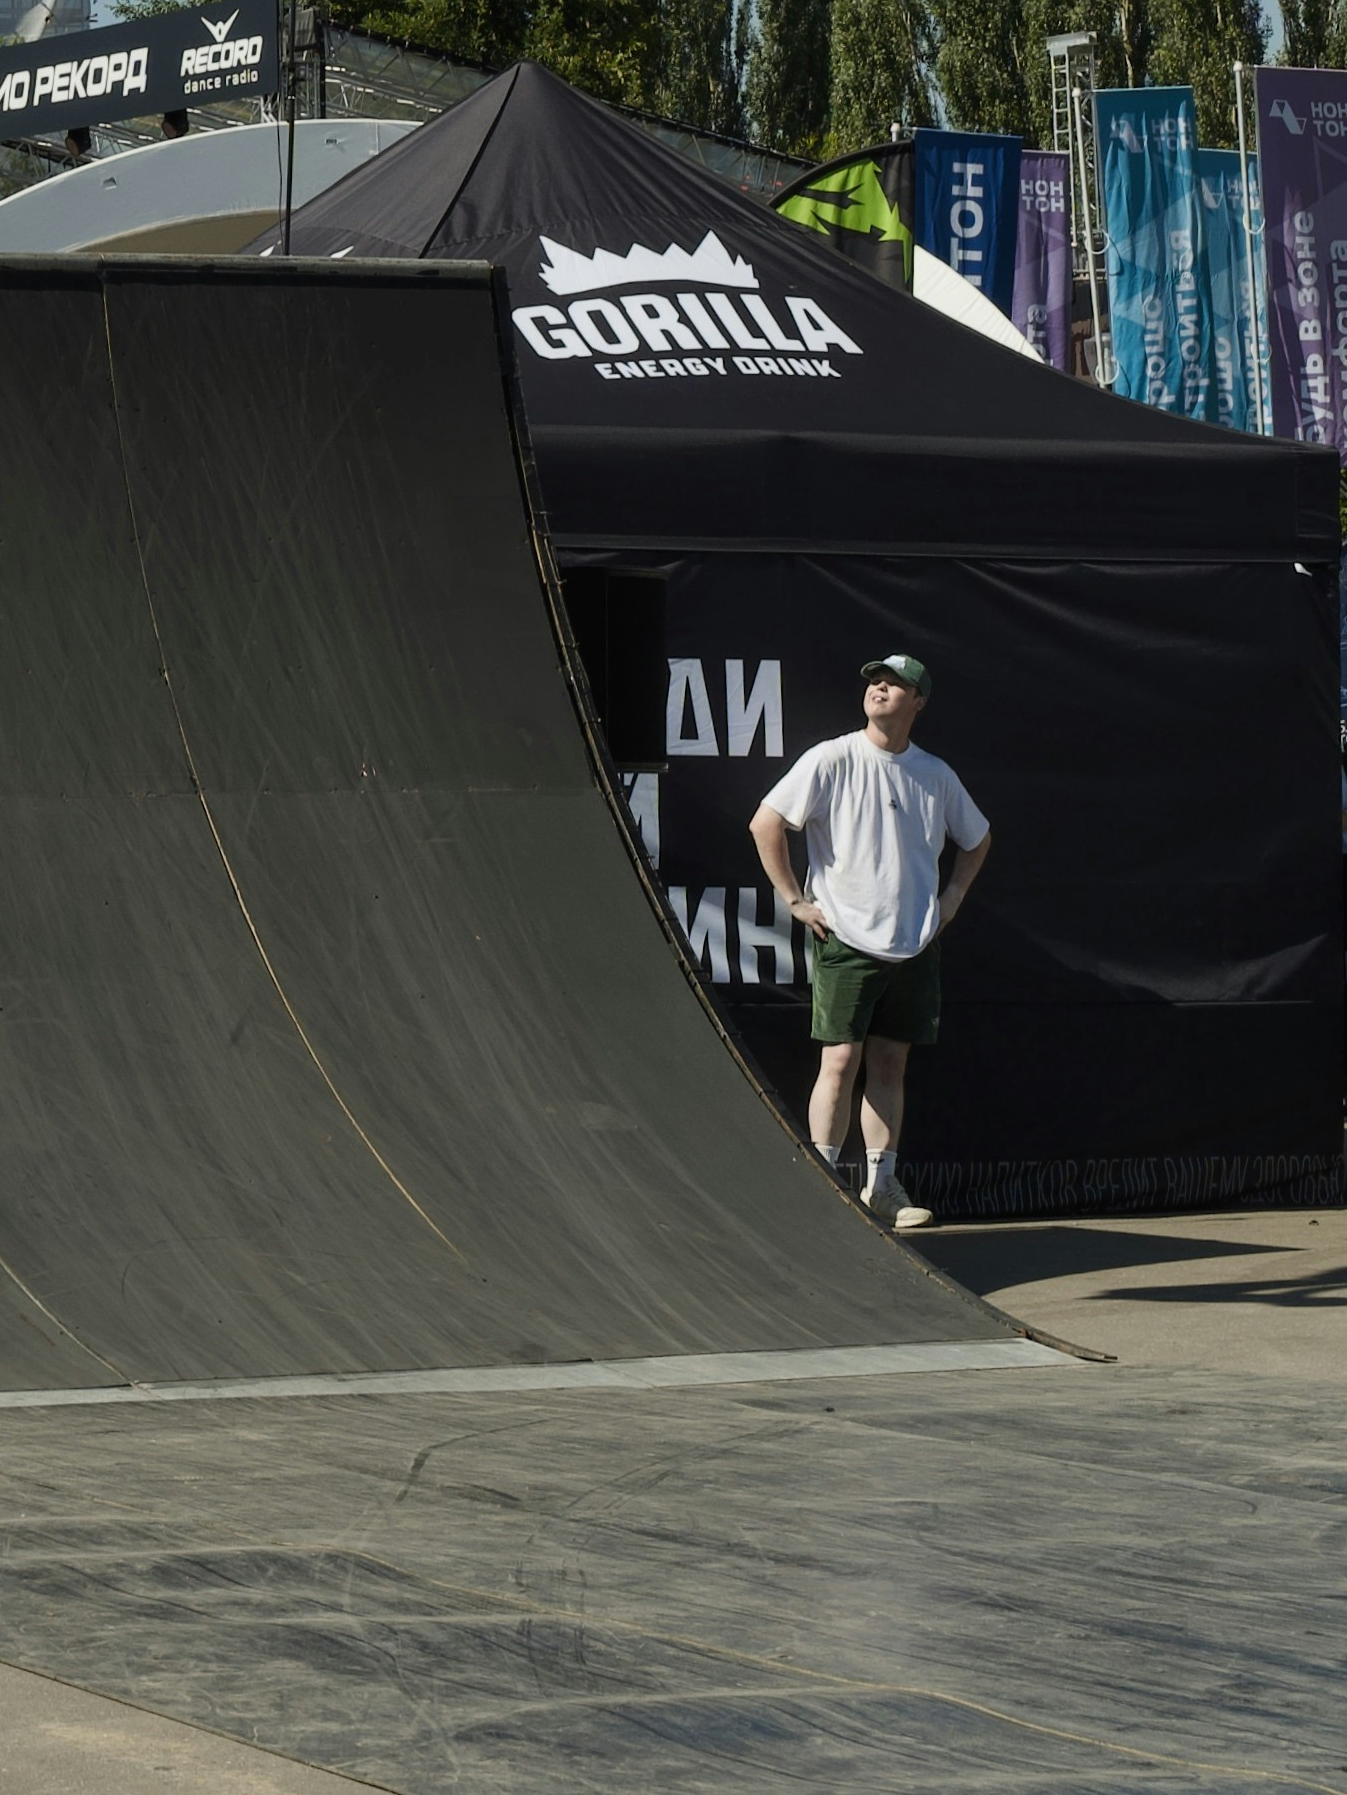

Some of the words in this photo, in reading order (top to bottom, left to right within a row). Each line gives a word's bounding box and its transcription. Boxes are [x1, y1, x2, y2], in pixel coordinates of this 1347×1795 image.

[180, 35, 263, 77] RECORD
[33, 47, 149, 107] РЕКОРД
[183, 76, 222, 95] dance
[225, 69, 260, 86] radio
[1020, 179, 1064, 197] НОН
[1021, 195, 1066, 213] ТОН
[1292, 211, 1320, 307] зоне
[511, 292, 864, 360] GORILLA
[1298, 319, 1323, 341] в
[594, 357, 728, 380] ENERGY
[731, 357, 842, 379] DRINK
